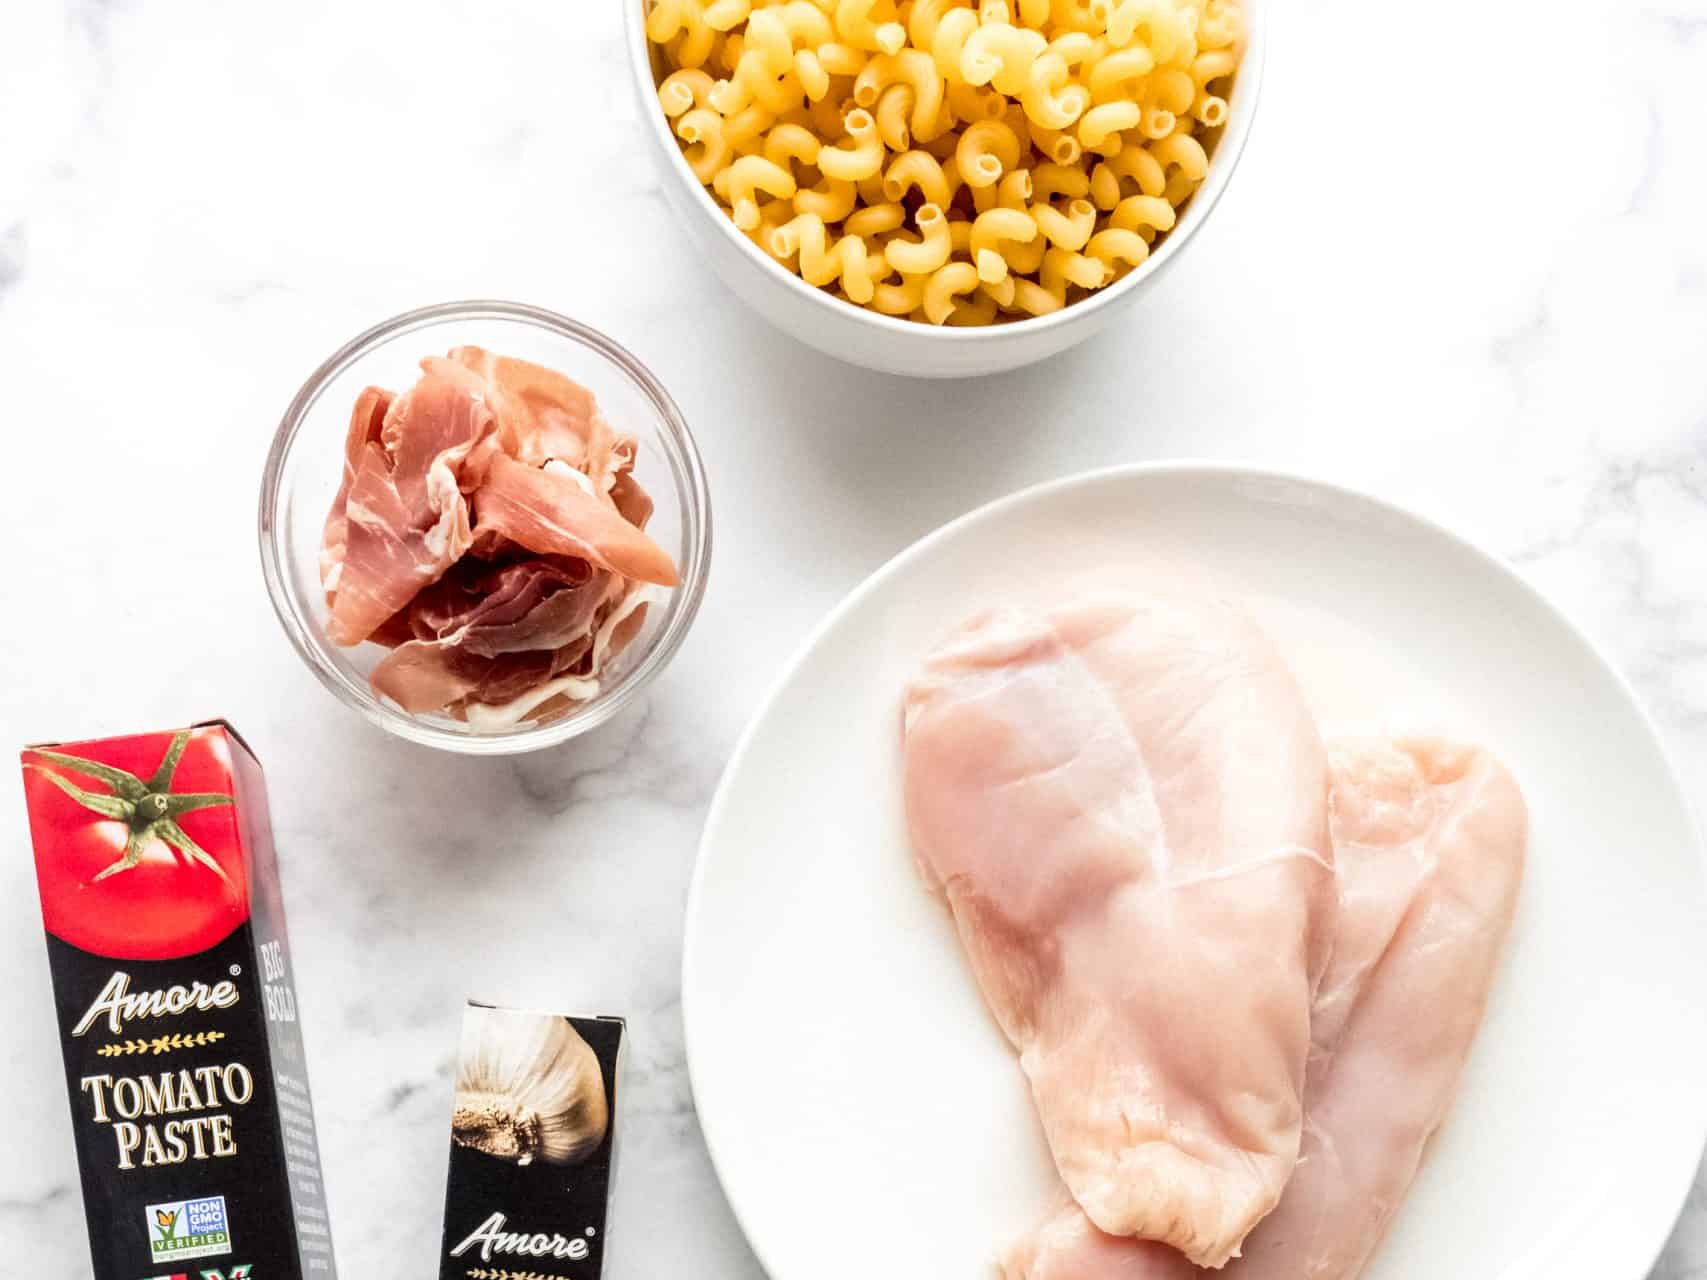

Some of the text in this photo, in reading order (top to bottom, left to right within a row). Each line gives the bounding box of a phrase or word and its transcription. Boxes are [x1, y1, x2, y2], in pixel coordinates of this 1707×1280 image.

[72, 971, 240, 1036] Amore
[81, 1061, 254, 1123] TOMATO
[112, 1114, 238, 1170] PASTE
[188, 1201, 220, 1213] NON
[190, 1211, 223, 1225] GMO
[157, 1233, 225, 1250] VERIFIED
[191, 1223, 224, 1234] Project
[450, 1212, 590, 1262] Amore
